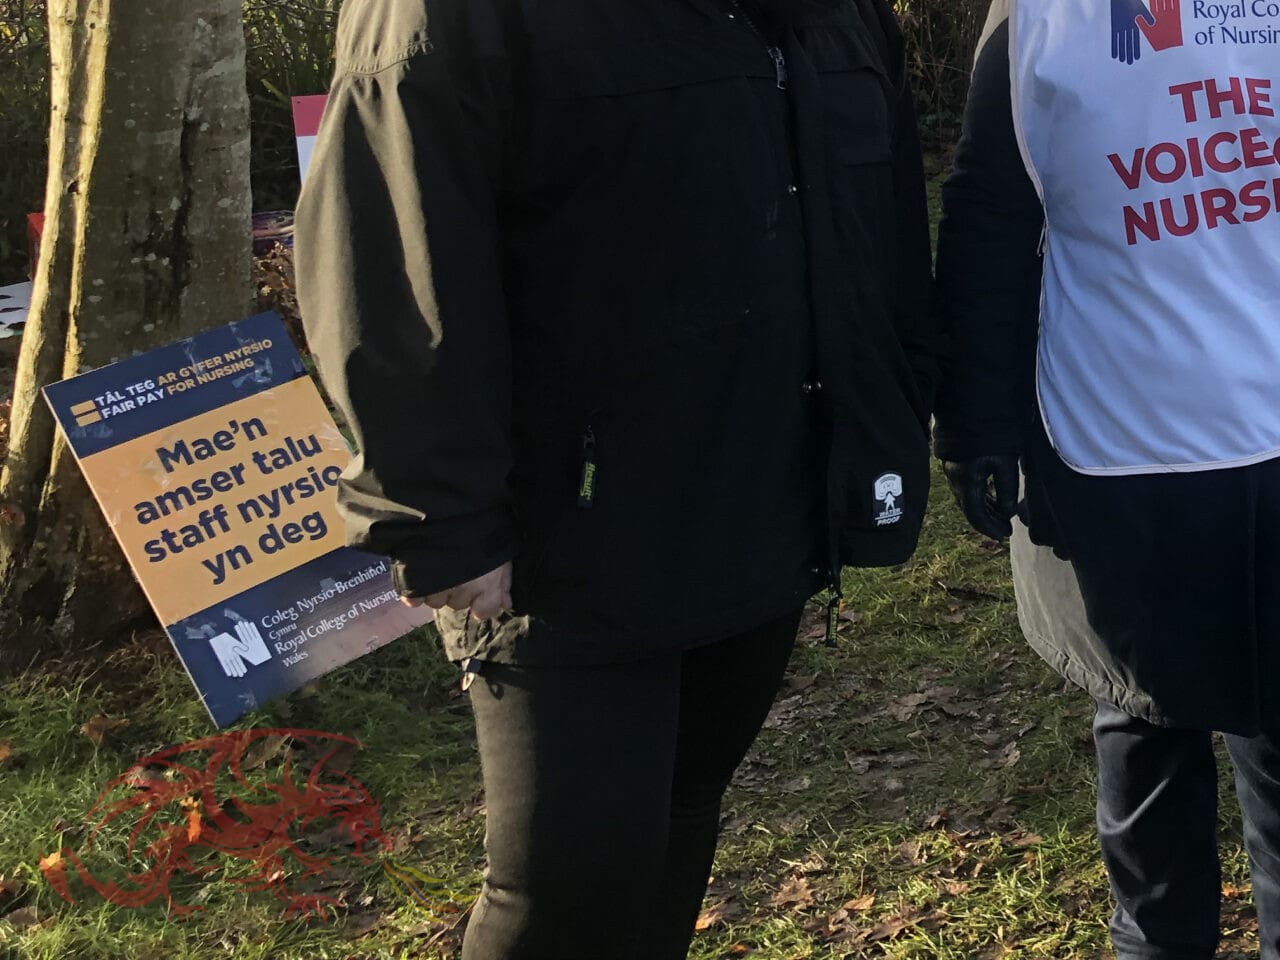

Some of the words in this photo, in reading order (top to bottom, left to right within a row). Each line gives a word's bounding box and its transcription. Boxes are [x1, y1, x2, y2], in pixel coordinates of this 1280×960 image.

[1195, 25, 1216, 46] of
[1168, 76, 1275, 124] THE
[1106, 127, 1276, 191] VOICE
[95, 391, 126, 407] TÂL
[125, 379, 155, 396] TEG
[158, 372, 178, 386] AR
[179, 355, 223, 378] GYFER
[224, 339, 273, 362] NYRSIO
[101, 398, 136, 419] FAIR
[137, 388, 165, 407] PAY
[166, 378, 196, 396] FOR
[197, 358, 255, 385] NURSING
[156, 417, 269, 474] Mae'n
[134, 462, 246, 525] amser
[252, 434, 323, 475] talu
[144, 504, 231, 563] staff
[237, 465, 343, 524] nyrsio
[201, 544, 254, 586] yn
[258, 511, 328, 555] deg
[261, 609, 299, 628] Coleg
[296, 589, 334, 613] Nyrsio
[334, 560, 387, 594] Brenhinol
[274, 630, 308, 654] Royal
[306, 613, 347, 638] College
[347, 604, 359, 619] of
[359, 589, 401, 613] Nursing
[268, 622, 298, 641] Cymru
[282, 650, 309, 667] Wales
